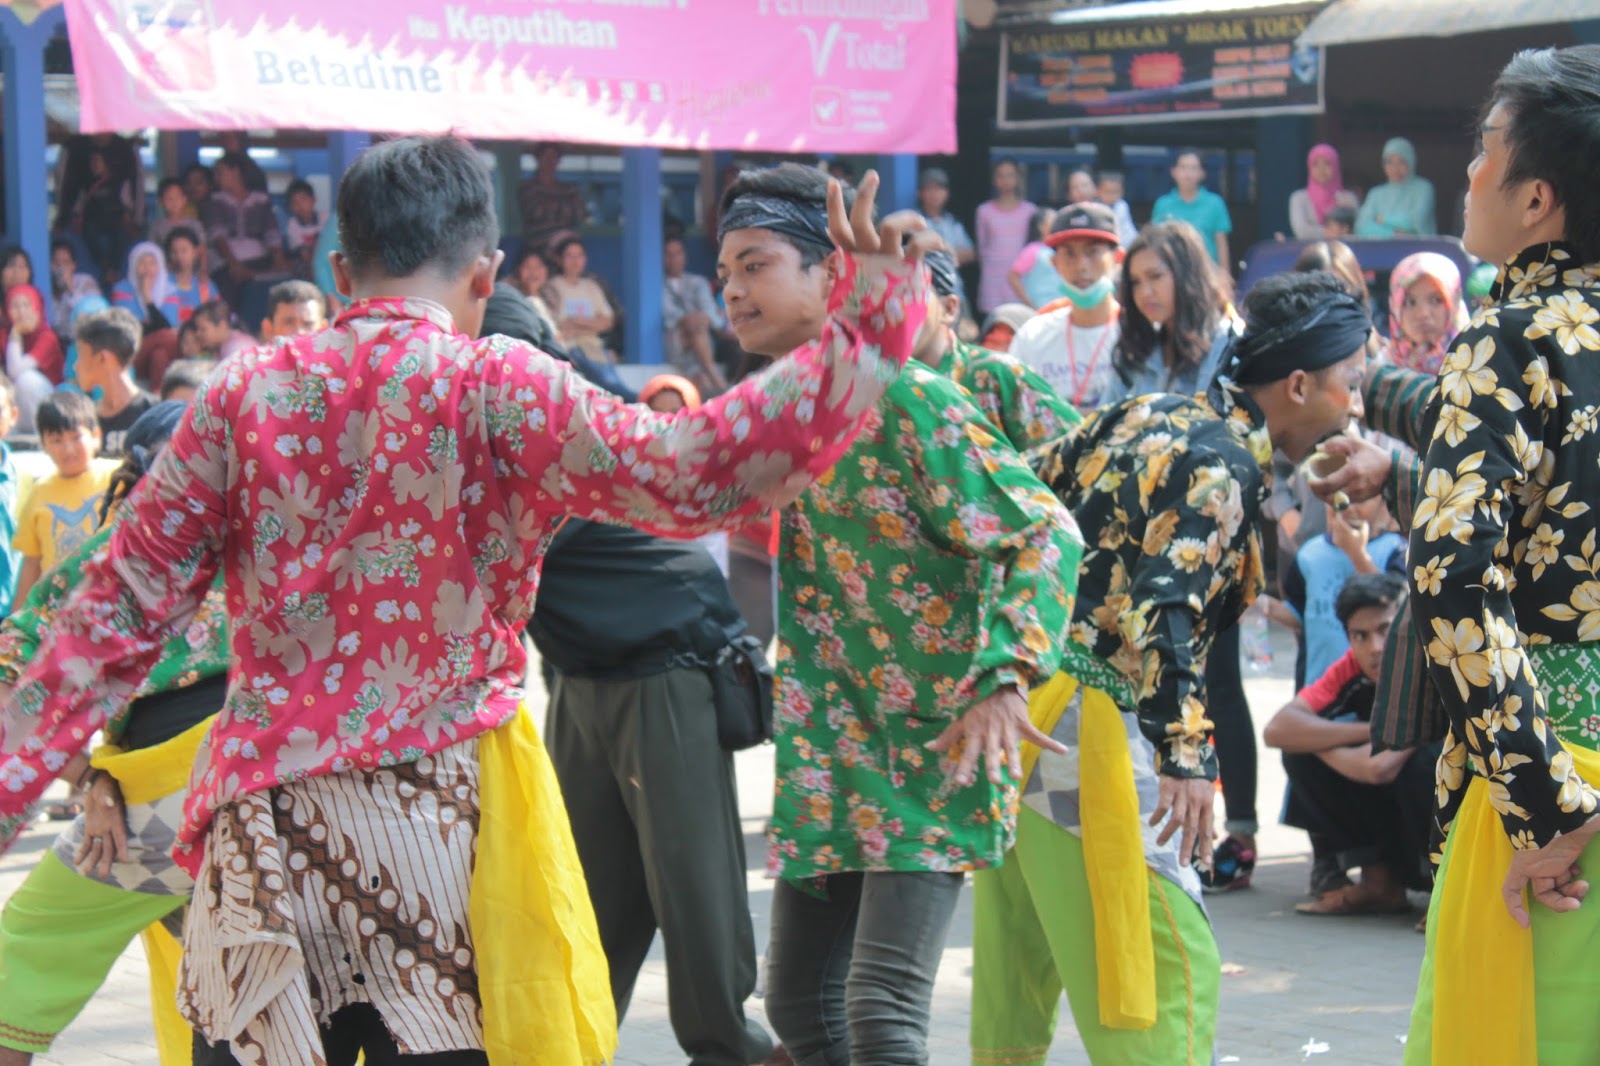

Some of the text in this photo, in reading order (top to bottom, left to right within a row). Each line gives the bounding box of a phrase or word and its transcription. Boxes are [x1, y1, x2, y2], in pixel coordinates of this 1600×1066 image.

[445, 4, 618, 51] Keputihan
[1095, 26, 1169, 48] MAKAN
[842, 32, 907, 70] Total
[253, 50, 442, 93] Betadine
